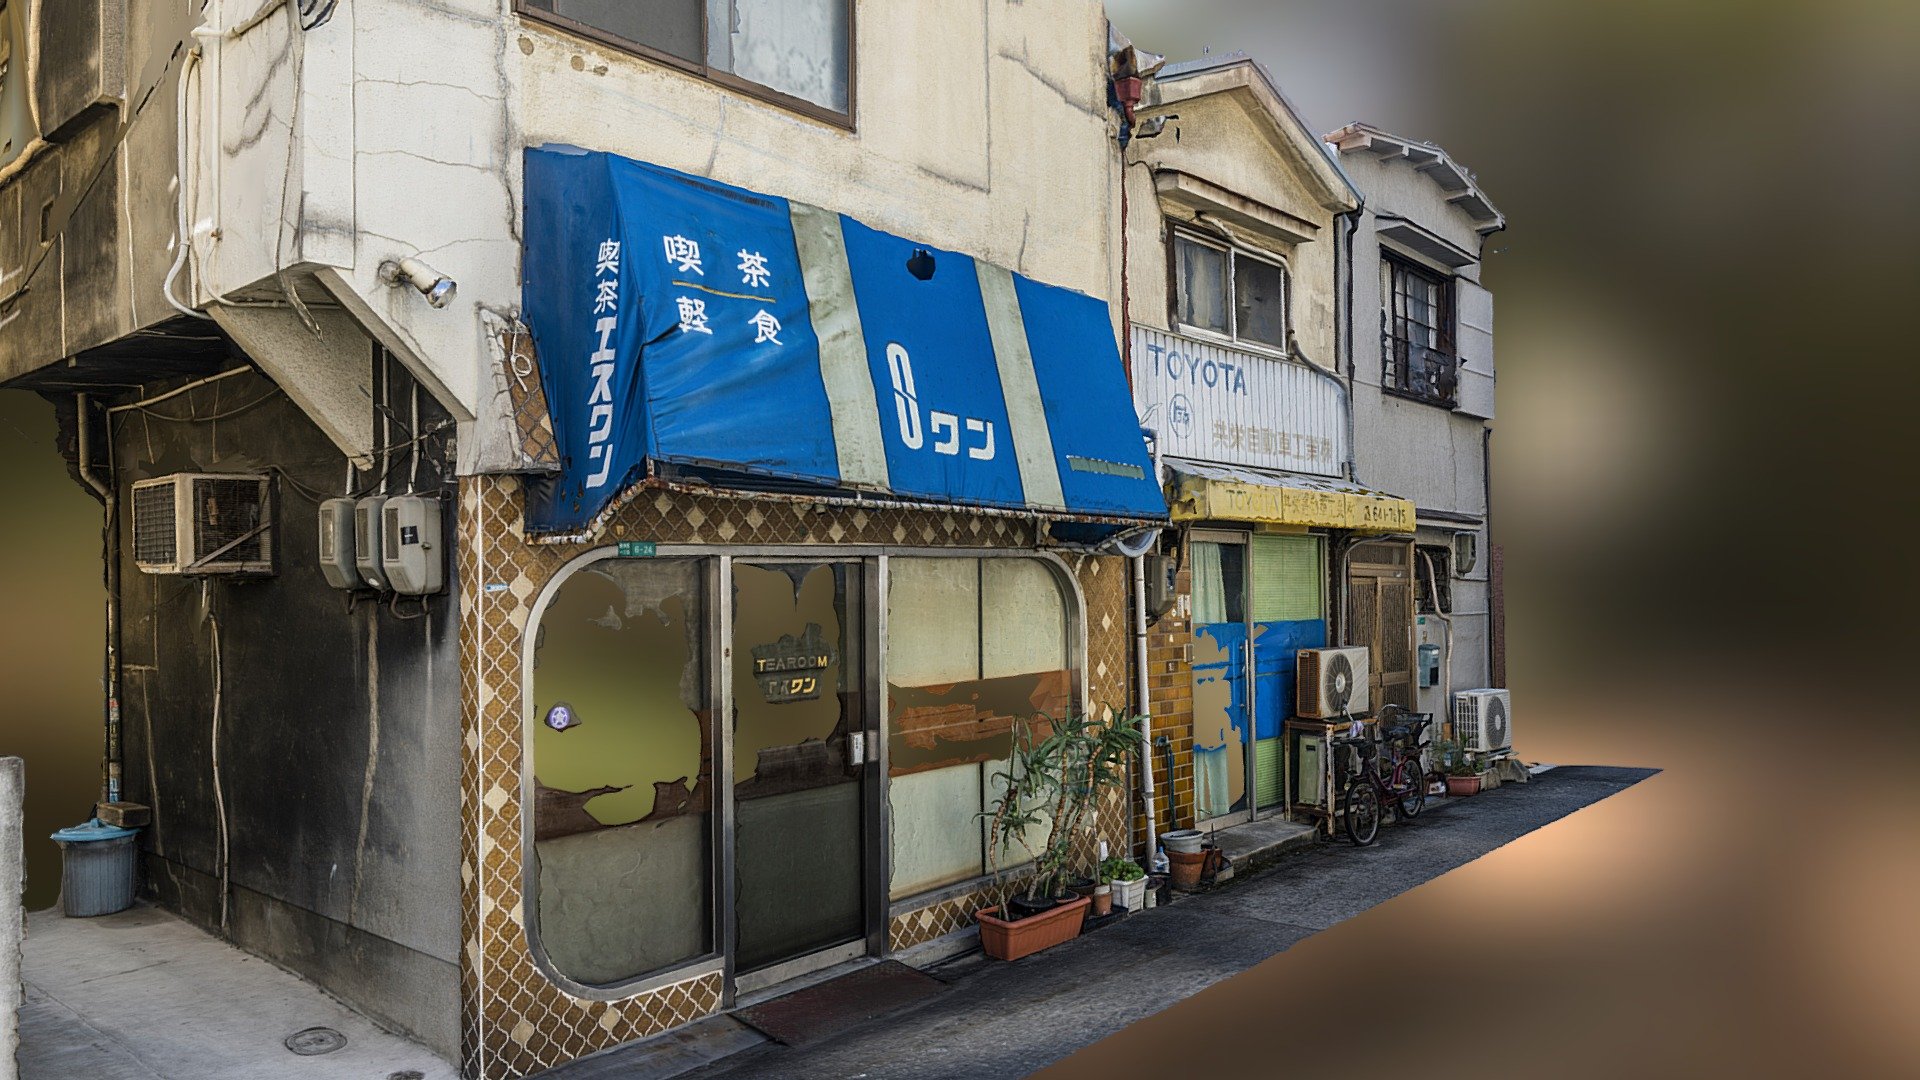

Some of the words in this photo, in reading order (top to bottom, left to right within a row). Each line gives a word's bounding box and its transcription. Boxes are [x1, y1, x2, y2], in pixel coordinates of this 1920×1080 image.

[663, 234, 772, 288] 喫茶
[675, 295, 784, 346] 軽食
[1148, 343, 1248, 397] TOYOTA
[757, 655, 828, 672] TEAROOM
